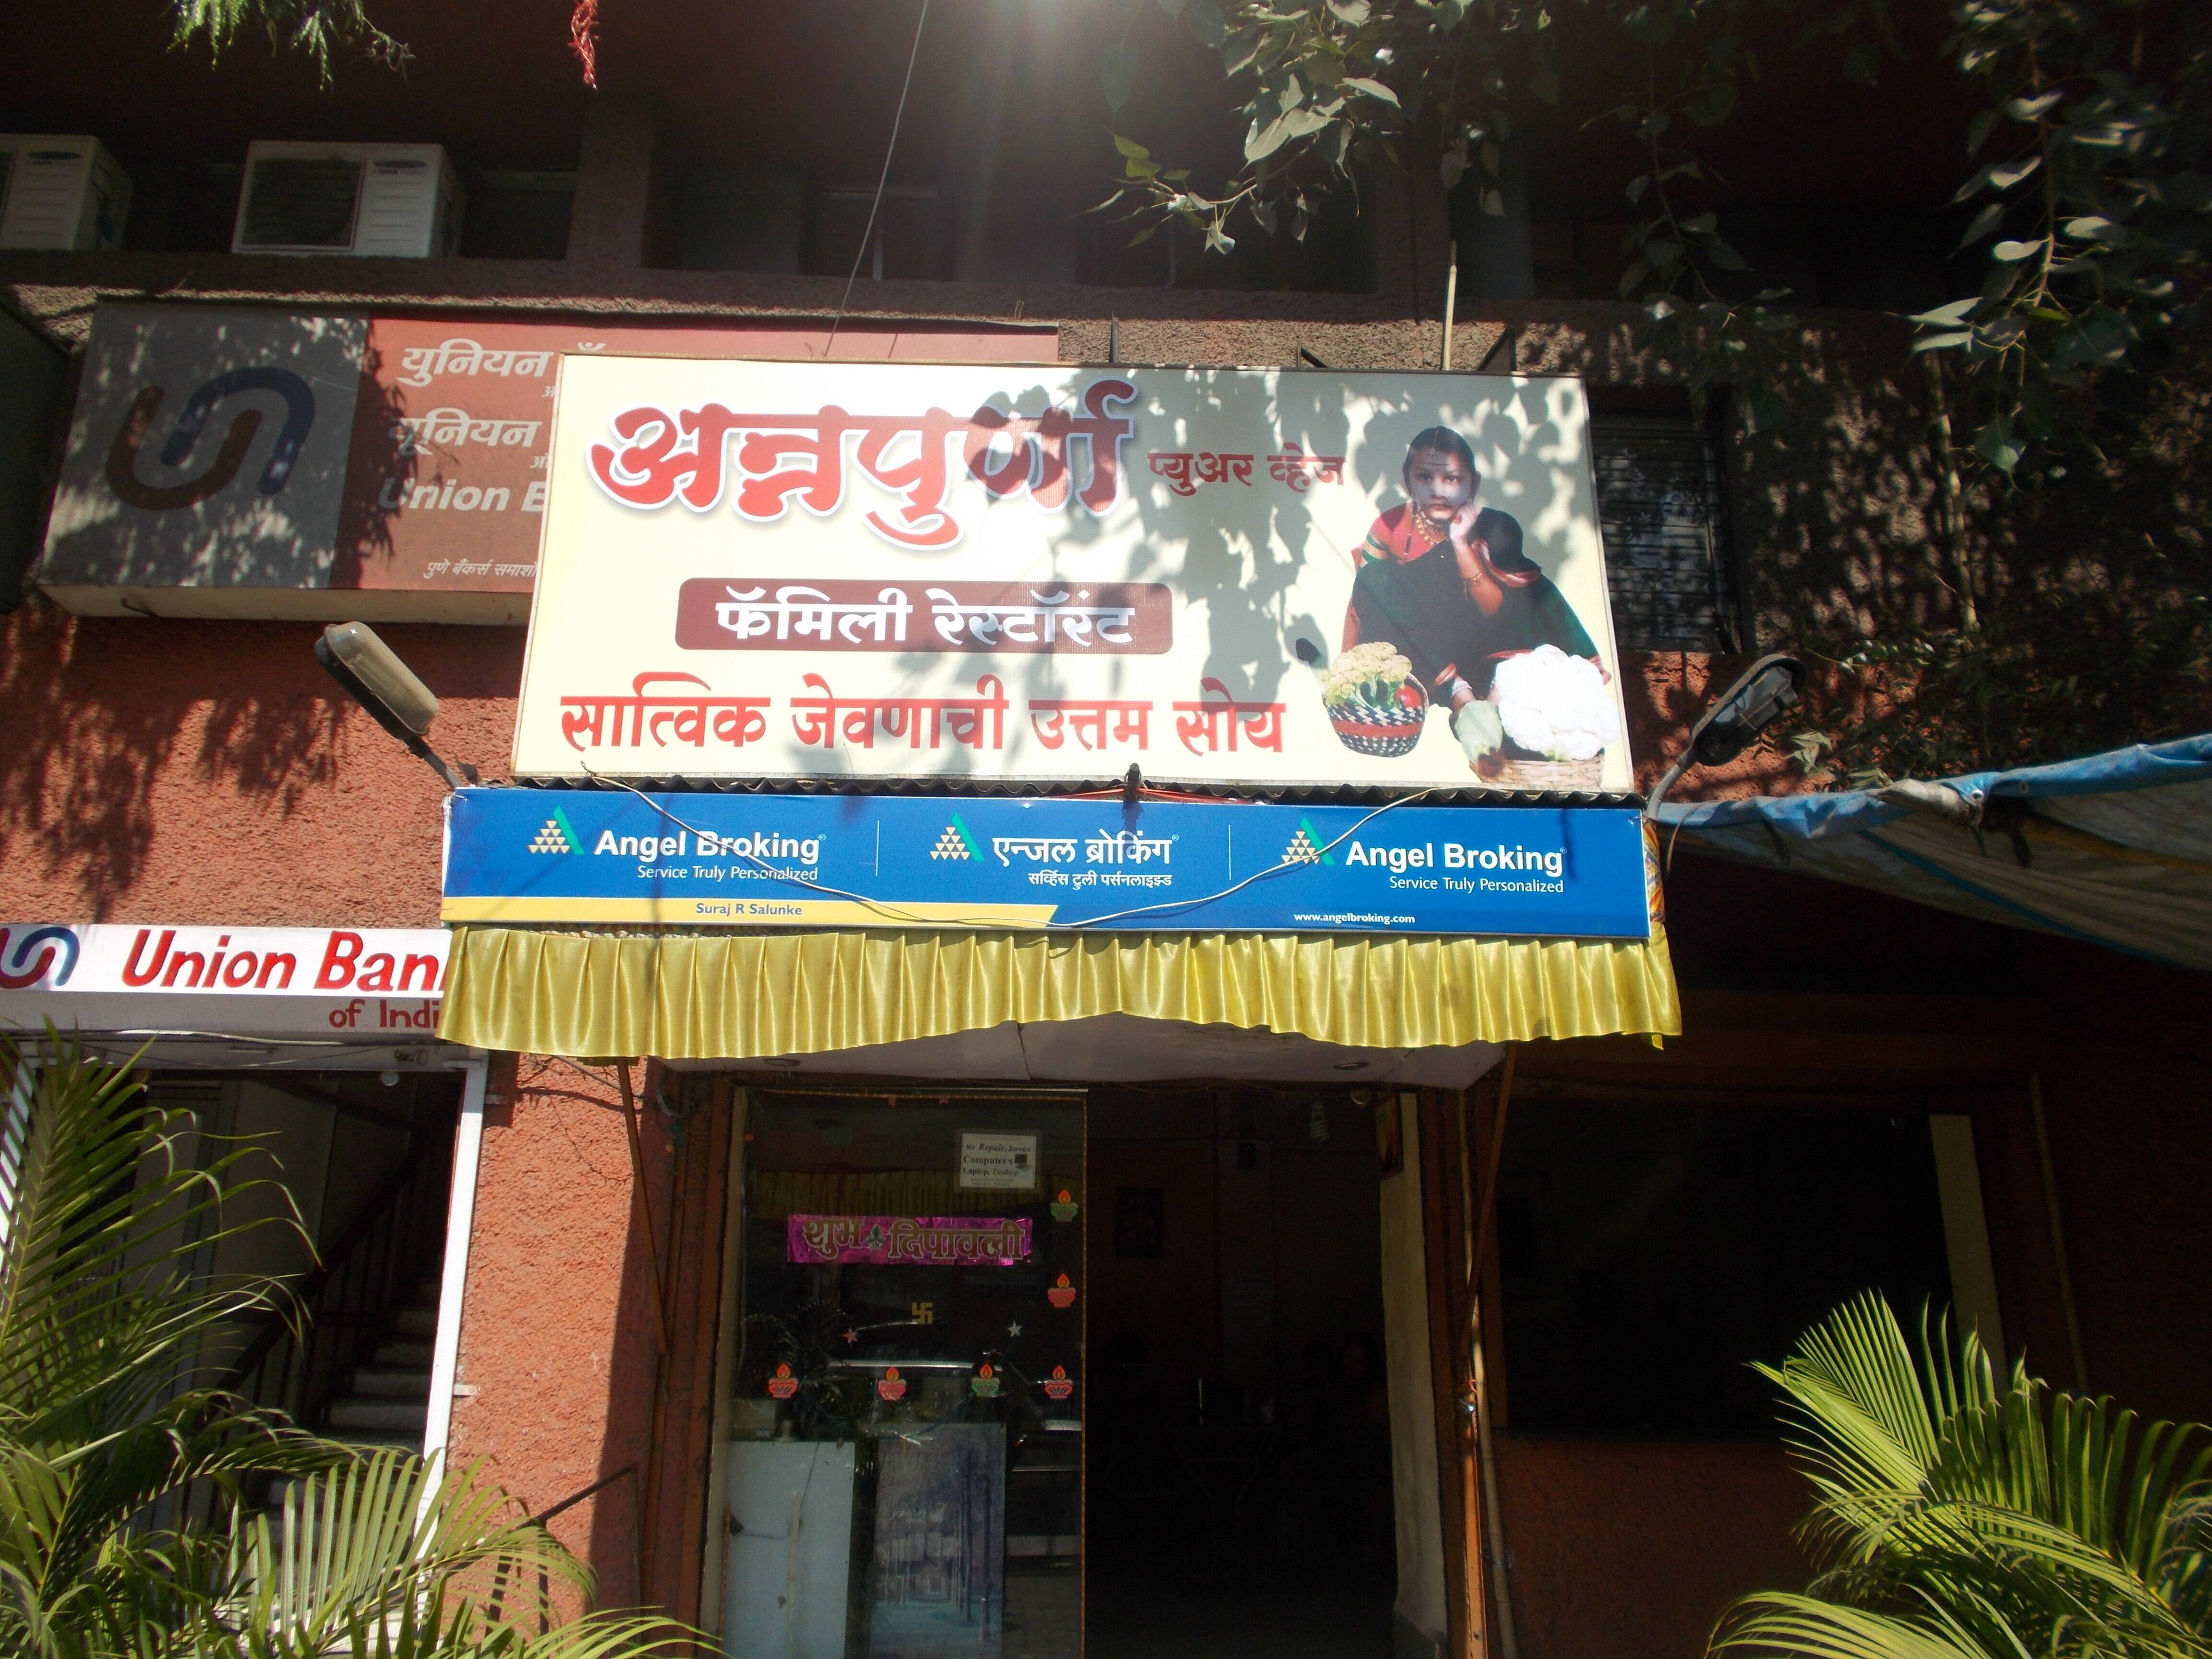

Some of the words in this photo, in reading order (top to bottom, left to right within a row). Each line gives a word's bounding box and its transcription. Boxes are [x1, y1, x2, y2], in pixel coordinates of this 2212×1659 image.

[397, 338, 554, 387] युनियन
[389, 408, 542, 456] यूनियन
[587, 377, 1138, 550] अन्नपुर्णा
[1147, 452, 1254, 496] प्युअर
[1267, 442, 1346, 493] व्हेज
[377, 476, 510, 511] Union
[423, 558, 450, 579] पुणे
[495, 561, 537, 577] समाशो
[715, 586, 913, 644] फॅमिली
[925, 587, 1135, 647] रेस्टॉरंट
[560, 672, 770, 751] सात्विक
[791, 673, 1009, 749] जेवणाची
[1028, 700, 1153, 751] उत्तम
[1172, 677, 1286, 757] सोय
[594, 830, 686, 863] Angel
[992, 838, 1078, 867] एन्जल
[1346, 841, 1433, 874] Angel
[637, 866, 687, 878] Service
[693, 866, 726, 882] Truly
[730, 866, 818, 880] Personalized
[1028, 870, 1069, 886] सर्व्हिस
[1390, 876, 1438, 890] Service
[1442, 877, 1475, 894] Truly
[1480, 878, 1564, 893] Personalized
[696, 902, 730, 916] Suraj
[736, 903, 745, 914] R
[749, 903, 802, 915] Salunke
[1294, 913, 1415, 925] www.angelbroking.com
[122, 928, 296, 988] Union
[313, 930, 448, 992] Ban
[329, 998, 366, 1028] of
[380, 999, 440, 1029] Indi
[803, 1219, 864, 1259] शुभ
[888, 1219, 1025, 1260] दिपावली
